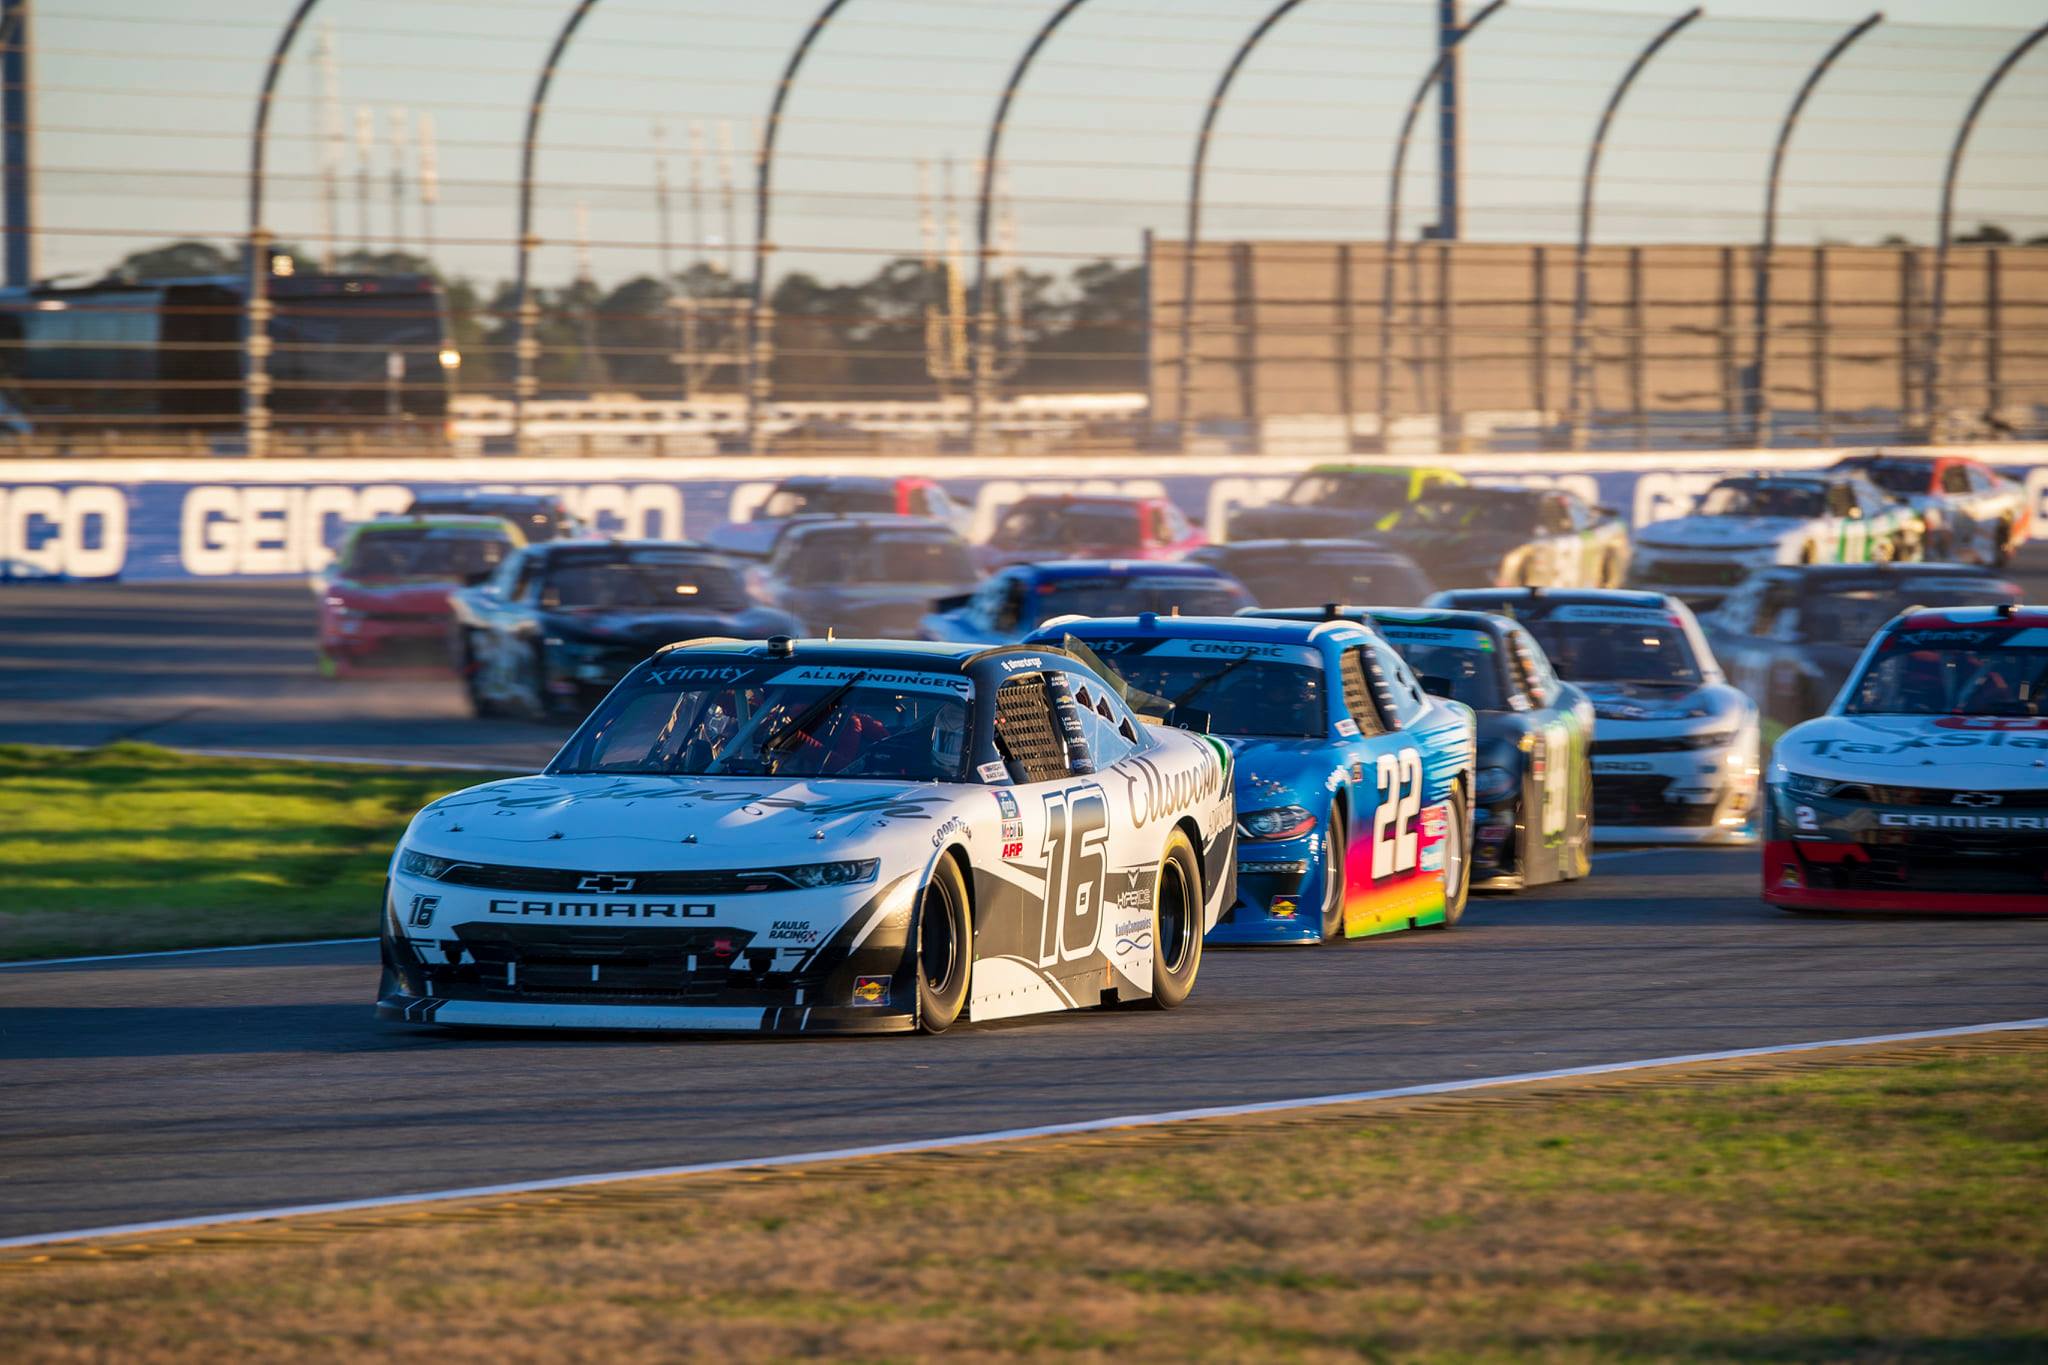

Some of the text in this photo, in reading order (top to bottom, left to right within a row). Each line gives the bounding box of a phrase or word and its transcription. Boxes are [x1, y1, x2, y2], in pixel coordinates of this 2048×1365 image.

[0, 486, 126, 577] CO
[1190, 643, 1285, 658] CINDRIC
[1371, 748, 1422, 880] 22
[1795, 806, 1819, 830] 2
[1879, 813, 2048, 829] CAMAR
[1002, 843, 1023, 858] ARP
[1039, 784, 1110, 968] 16
[408, 893, 442, 929] 16
[489, 900, 716, 918] CAMARO
[771, 920, 810, 930] KAULIG
[769, 930, 807, 940] RACING
